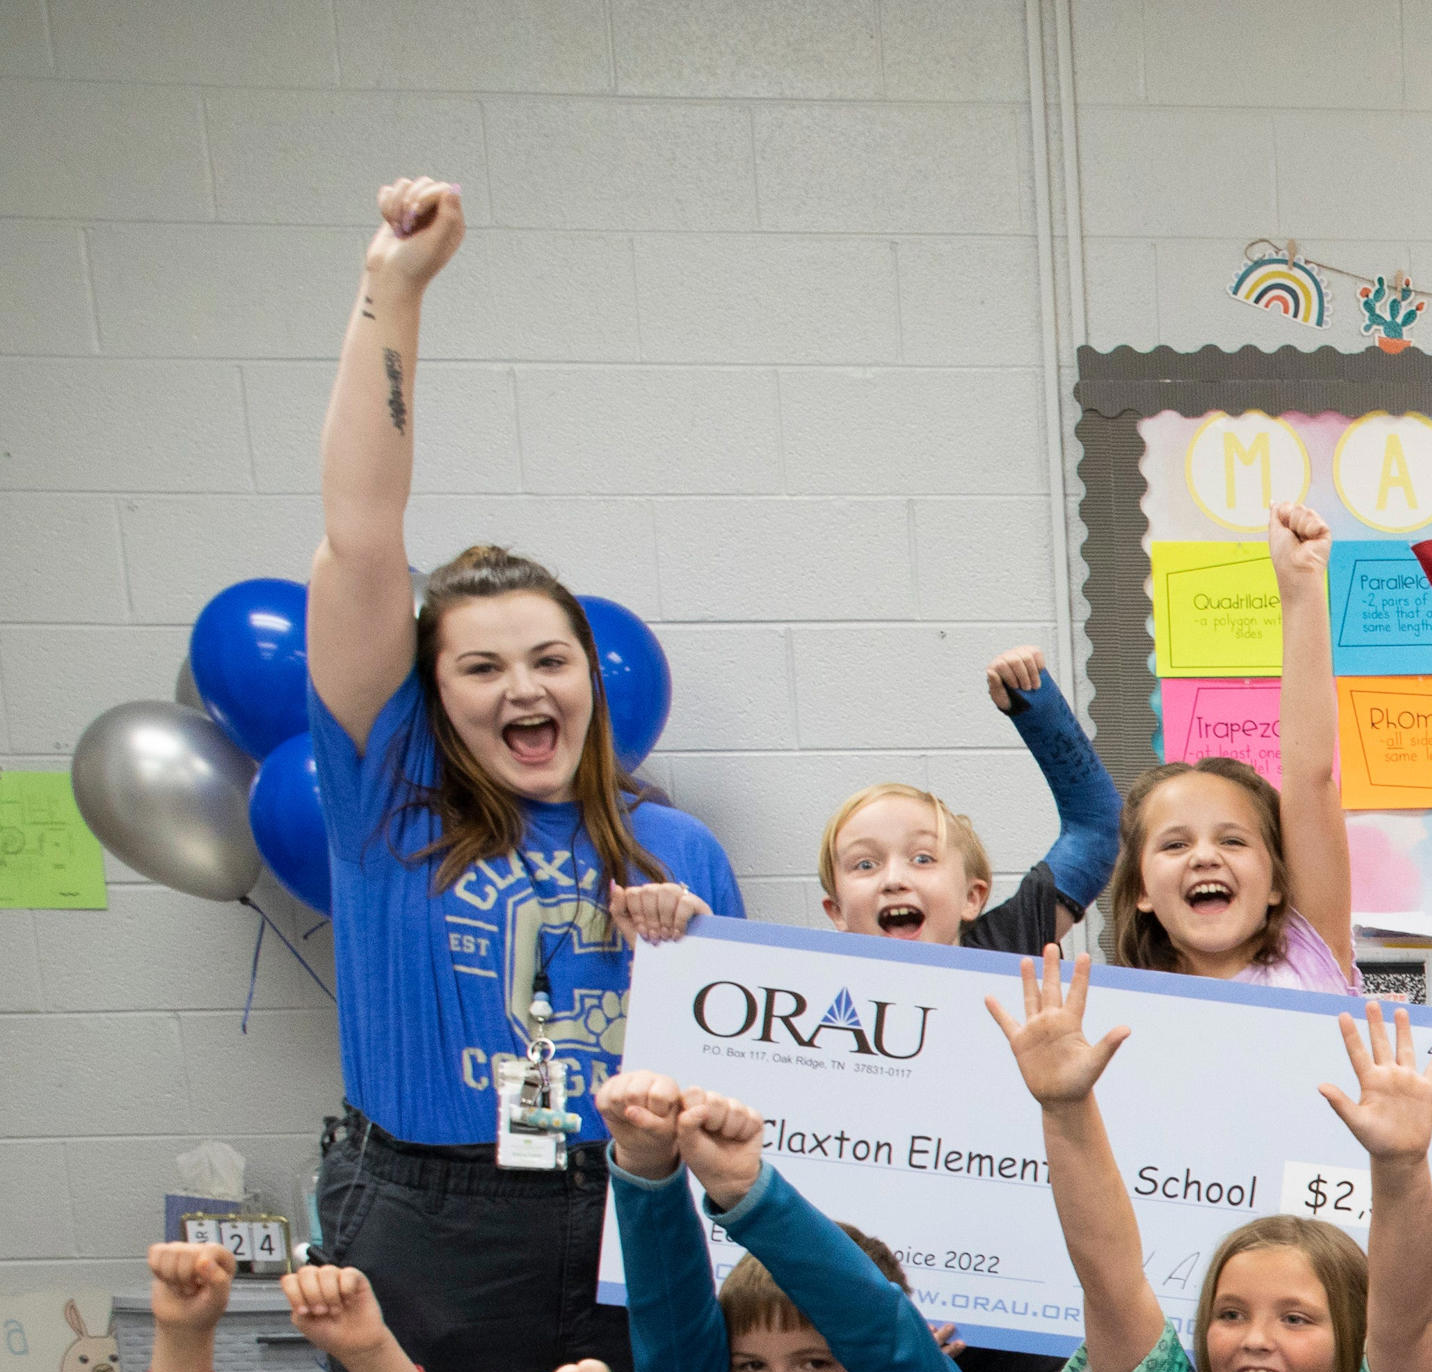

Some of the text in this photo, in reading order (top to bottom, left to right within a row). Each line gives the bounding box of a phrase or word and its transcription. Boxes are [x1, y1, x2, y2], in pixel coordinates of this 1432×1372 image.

[1360, 574, 1430, 590] Parallelo
[1382, 598, 1409, 612] pairs
[1415, 593, 1428, 605] of
[1362, 606, 1420, 619] sides that
[1214, 613, 1257, 632] polygon
[1263, 614, 1281, 625] wit
[1363, 619, 1432, 637] same length
[1385, 752, 1417, 762] same
[450, 932, 490, 956] EST
[693, 980, 940, 1060] ORAU
[703, 1044, 912, 1079] P.O. Box 117, Oak Ridge, TN 37831-0117
[761, 1119, 893, 1165] Claxton
[908, 1135, 1052, 1185] Element
[1134, 1165, 1258, 1209] School
[944, 1250, 1000, 1275] 2022
